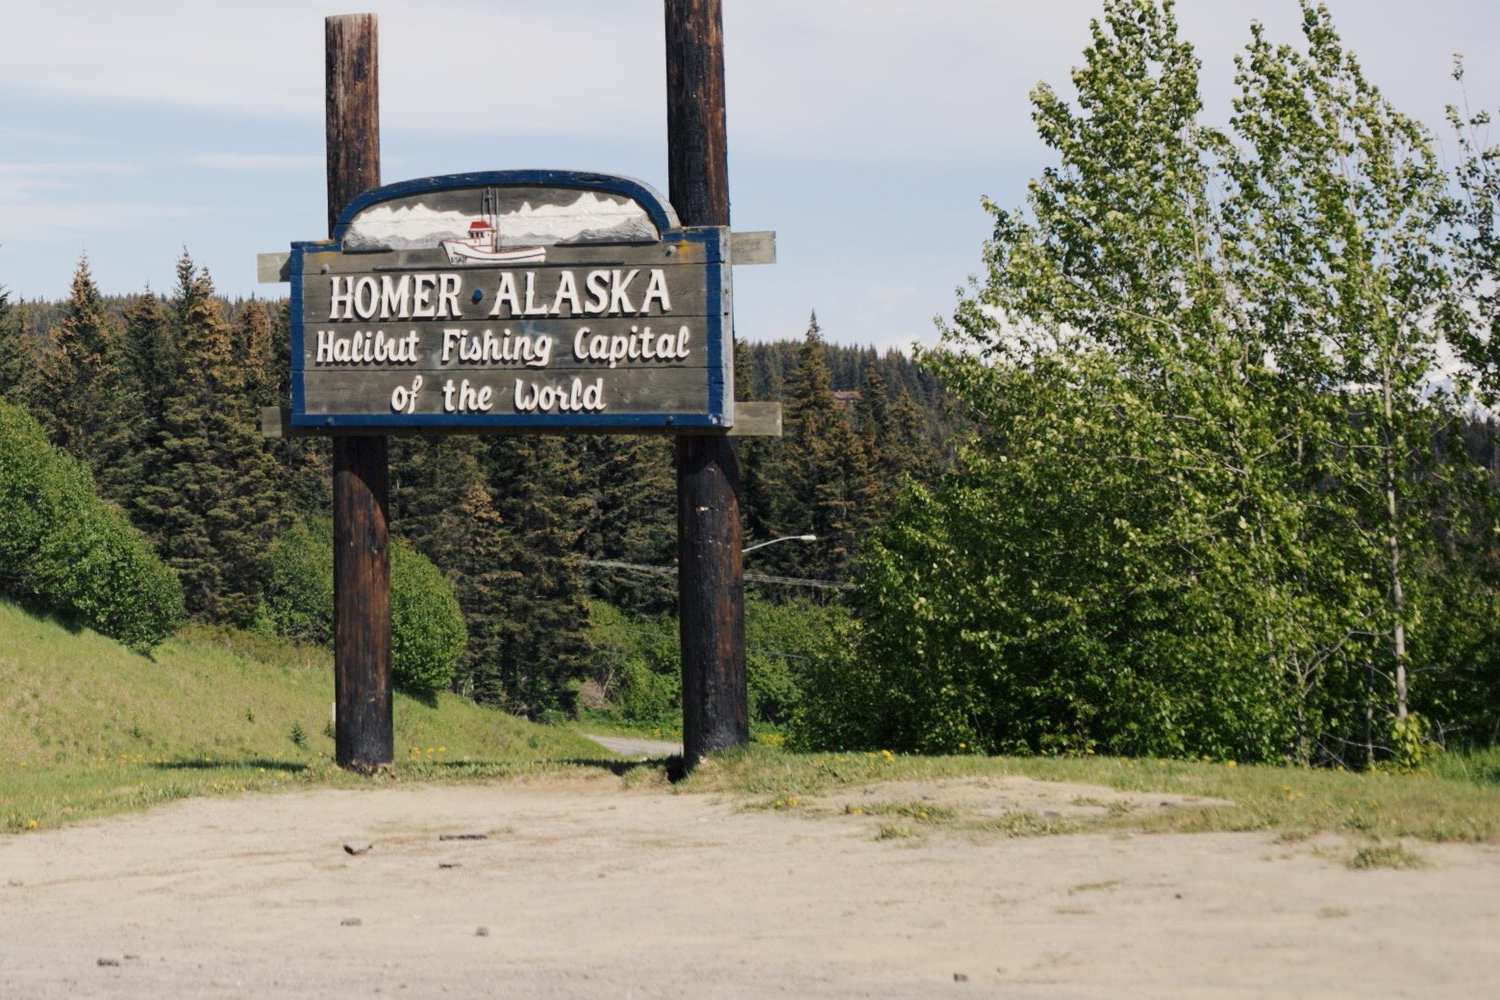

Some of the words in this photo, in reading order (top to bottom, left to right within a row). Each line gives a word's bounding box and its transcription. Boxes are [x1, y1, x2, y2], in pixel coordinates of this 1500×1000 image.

[329, 273, 463, 320] HOMER
[489, 268, 672, 317] ALASKA
[316, 330, 419, 364] Halibut
[442, 328, 553, 367] Fishing
[574, 325, 690, 368] Capital
[391, 374, 423, 414] of
[443, 379, 494, 412] the
[514, 377, 605, 412] World
